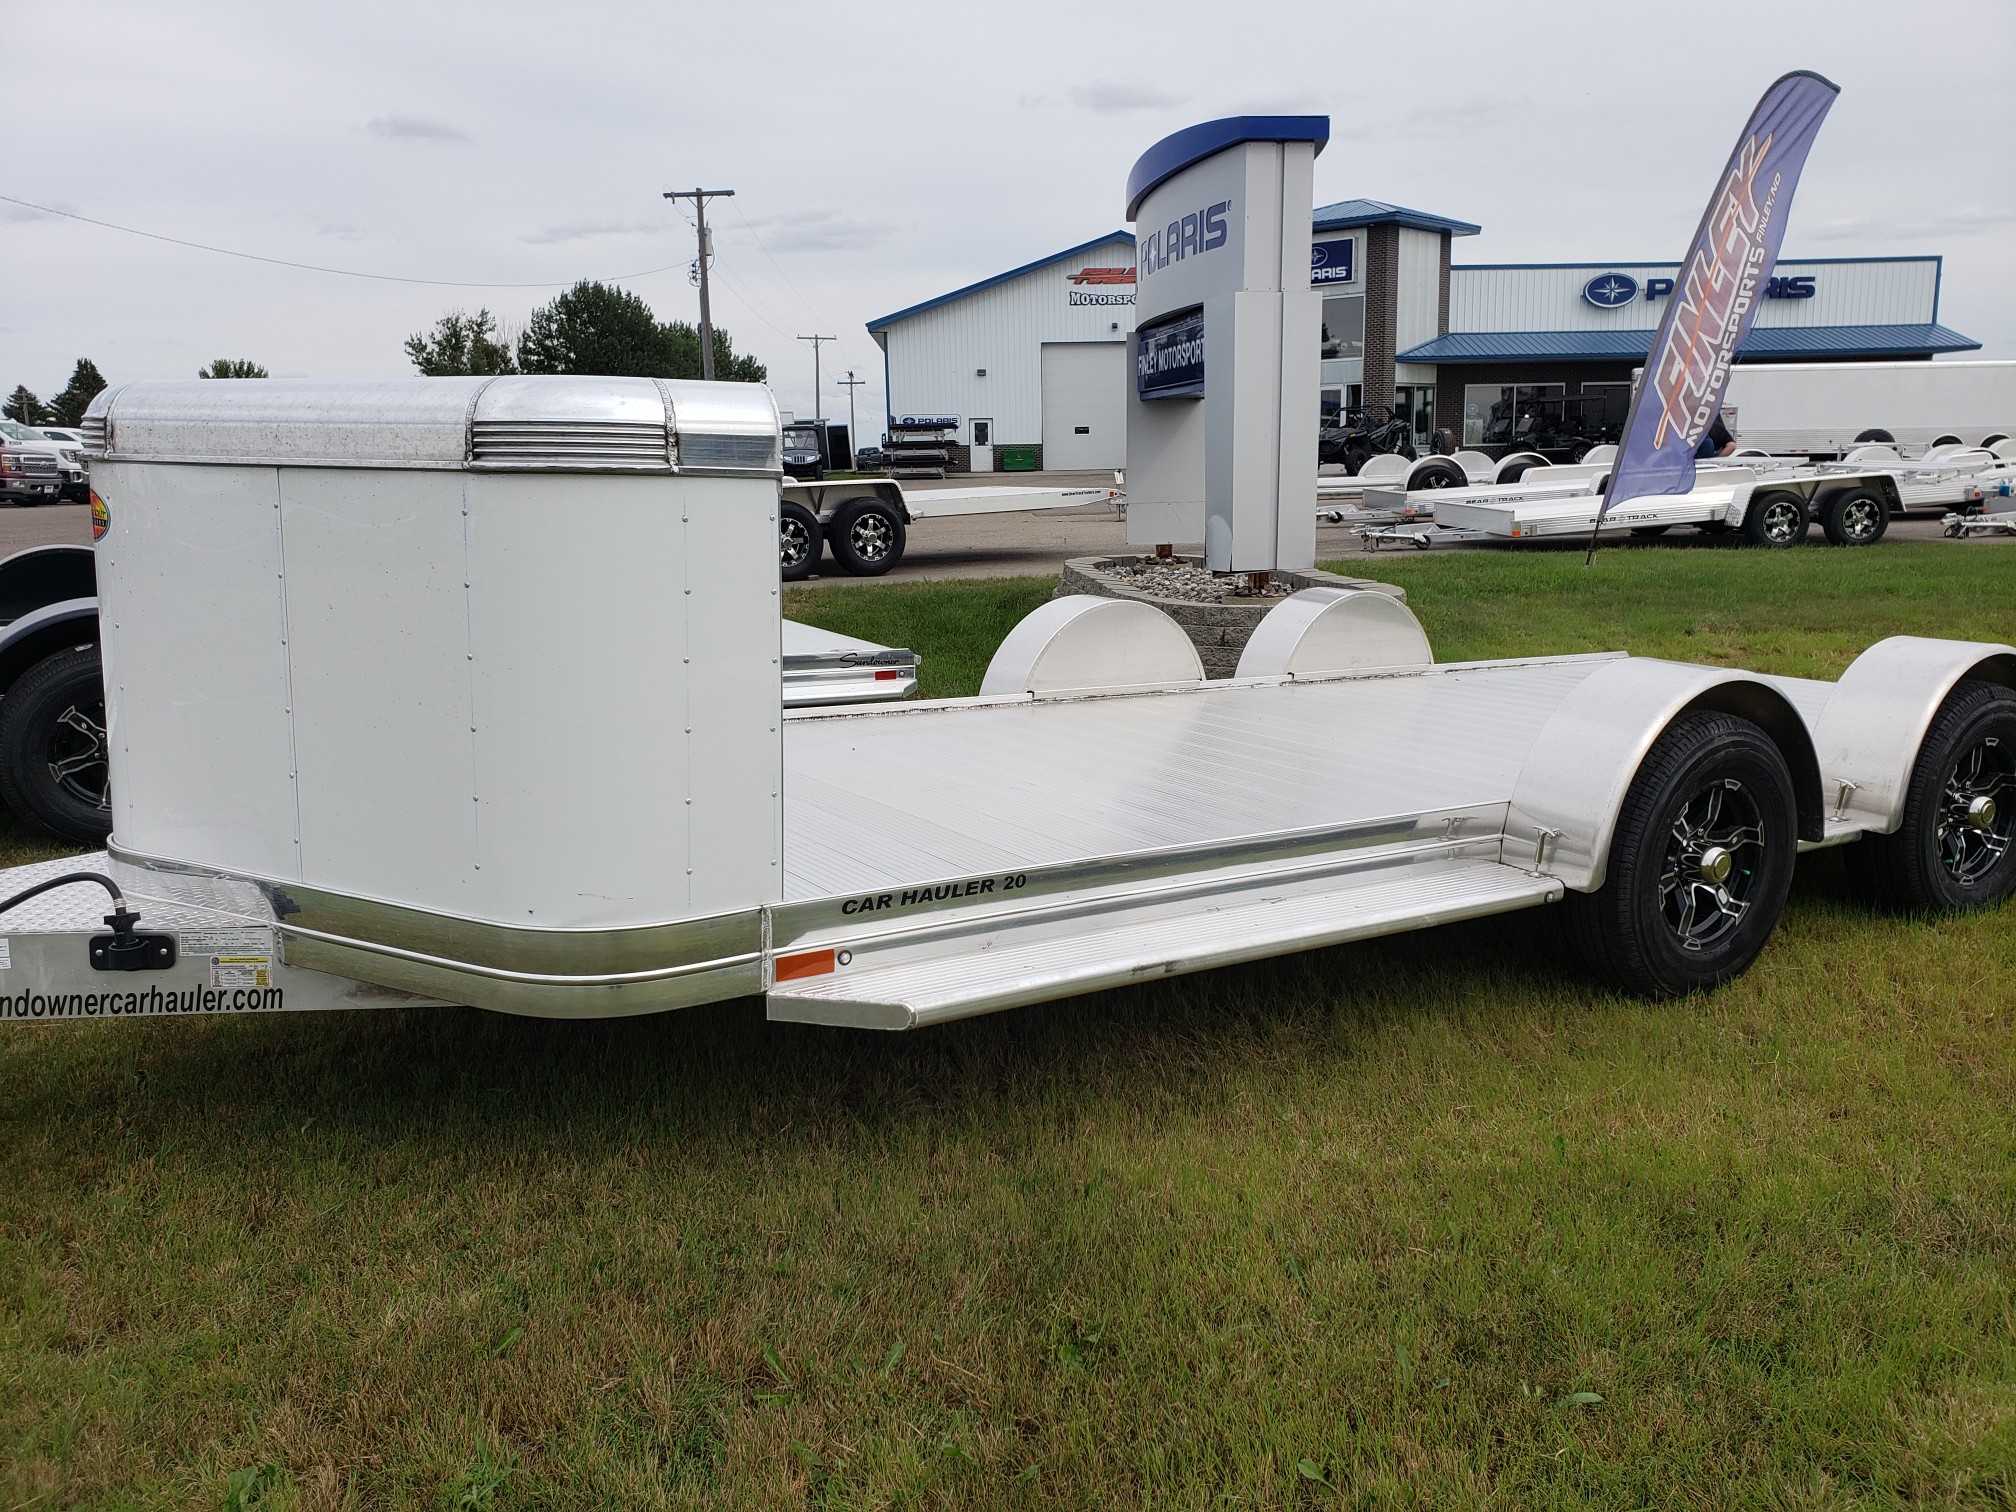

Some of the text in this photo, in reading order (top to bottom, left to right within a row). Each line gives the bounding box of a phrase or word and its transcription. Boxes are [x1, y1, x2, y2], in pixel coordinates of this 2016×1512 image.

[1770, 172, 1780, 196] ND
[1141, 200, 1228, 281] POLARIS
[1311, 266, 1347, 280] ARIS
[1070, 291, 1136, 306] MOTORSPO
[1654, 134, 1768, 444] FINLEY
[1687, 247, 1765, 447] MOTORSPORTS
[1138, 352, 1158, 376] FINLEY
[840, 653, 899, 669] Sundowner
[841, 874, 1027, 915] CAR HAULER 20
